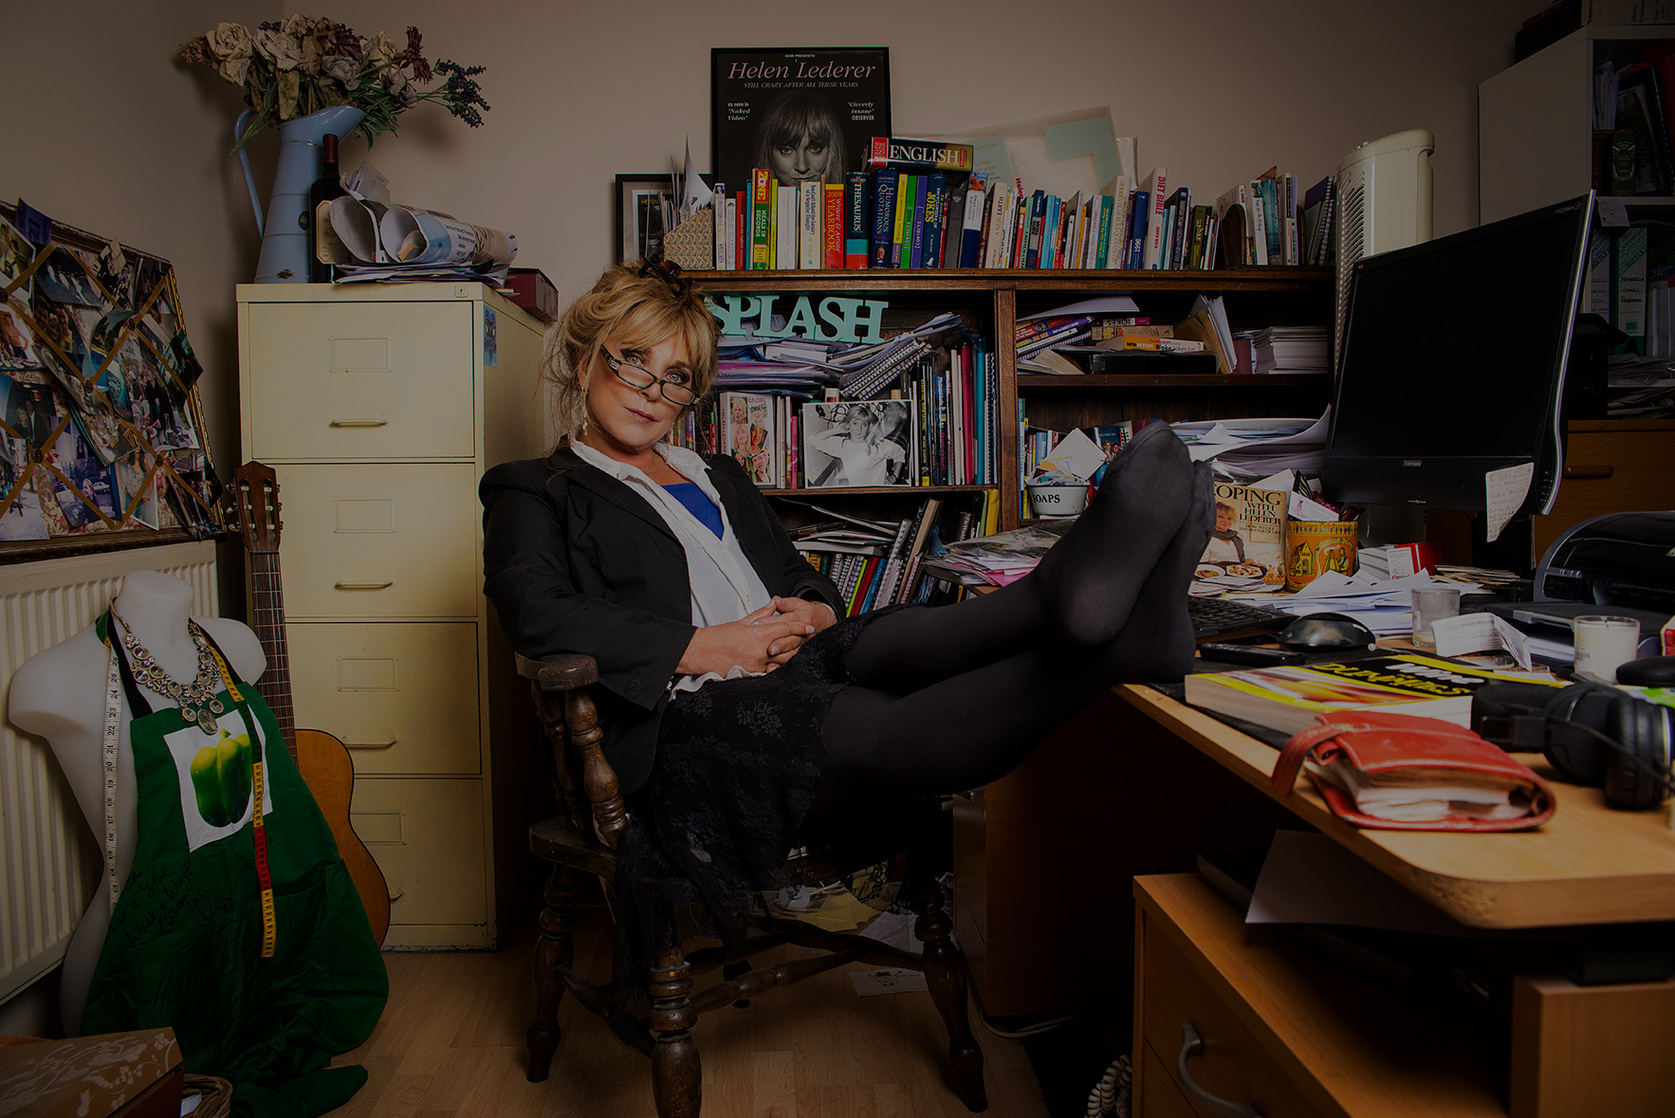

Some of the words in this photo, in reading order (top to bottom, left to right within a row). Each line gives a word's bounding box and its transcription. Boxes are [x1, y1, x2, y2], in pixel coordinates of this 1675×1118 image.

[728, 60, 790, 80] Helen
[795, 60, 877, 79] Lederer
[888, 143, 960, 165] ENGLISH
[757, 170, 768, 202] ZONE
[1015, 177, 1024, 200] Helen
[1157, 176, 1166, 194] DIET
[826, 190, 843, 198] 2009
[853, 183, 862, 232] THESAURUS
[876, 184, 888, 236] QUOTATIONS
[882, 187, 894, 233] HUMOROUS
[924, 191, 936, 223] JOKES
[996, 196, 1004, 216] EARTH
[1155, 194, 1165, 216] BIBLE
[827, 198, 836, 252] YEARBOOK
[1134, 238, 1142, 253] 1996
[702, 295, 889, 344] SPLASH
[1214, 484, 1281, 505] OPING
[1244, 508, 1277, 518] HELEN
[1247, 502, 1275, 511] WITH
[1239, 514, 1281, 525] LEDERER
[110, 673, 117, 683] 25
[110, 689, 118, 699] 24
[108, 707, 117, 718] 23
[107, 725, 116, 736] 22
[106, 745, 114, 754] 21
[106, 761, 113, 772] 20
[107, 779, 114, 789] 19
[107, 797, 113, 807] 18
[107, 815, 113, 824] 17
[108, 832, 114, 842] 16
[110, 868, 116, 876] 14
